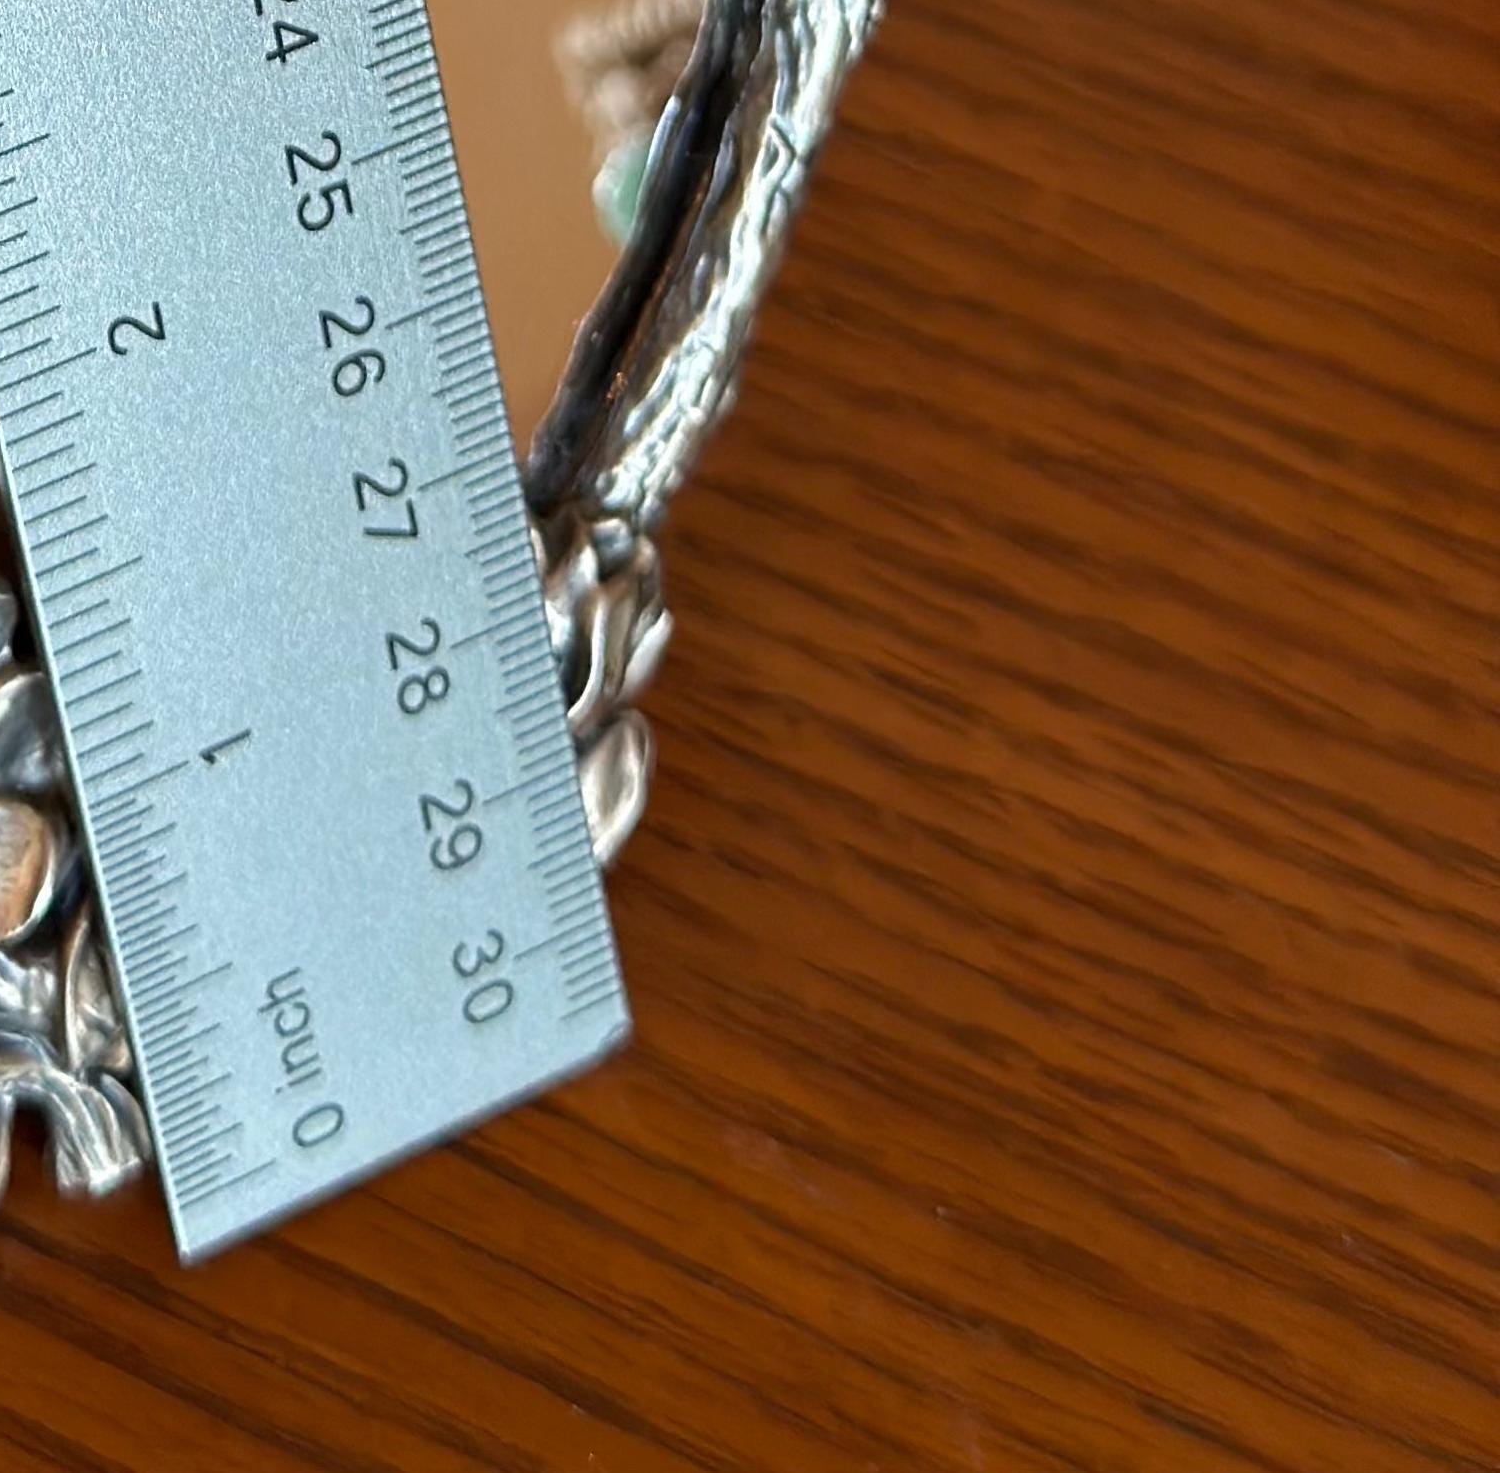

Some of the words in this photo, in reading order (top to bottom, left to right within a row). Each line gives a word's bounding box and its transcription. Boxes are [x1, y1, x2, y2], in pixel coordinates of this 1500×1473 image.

[284, 130, 354, 233] 25
[107, 301, 167, 357] 2
[319, 295, 387, 398] 26
[352, 458, 420, 540] 27
[385, 618, 452, 717] 28
[200, 729, 251, 766] 1
[419, 779, 484, 872] 29
[451, 929, 515, 1026] 30
[258, 967, 322, 1093] inch
[292, 1103, 345, 1149] 0
